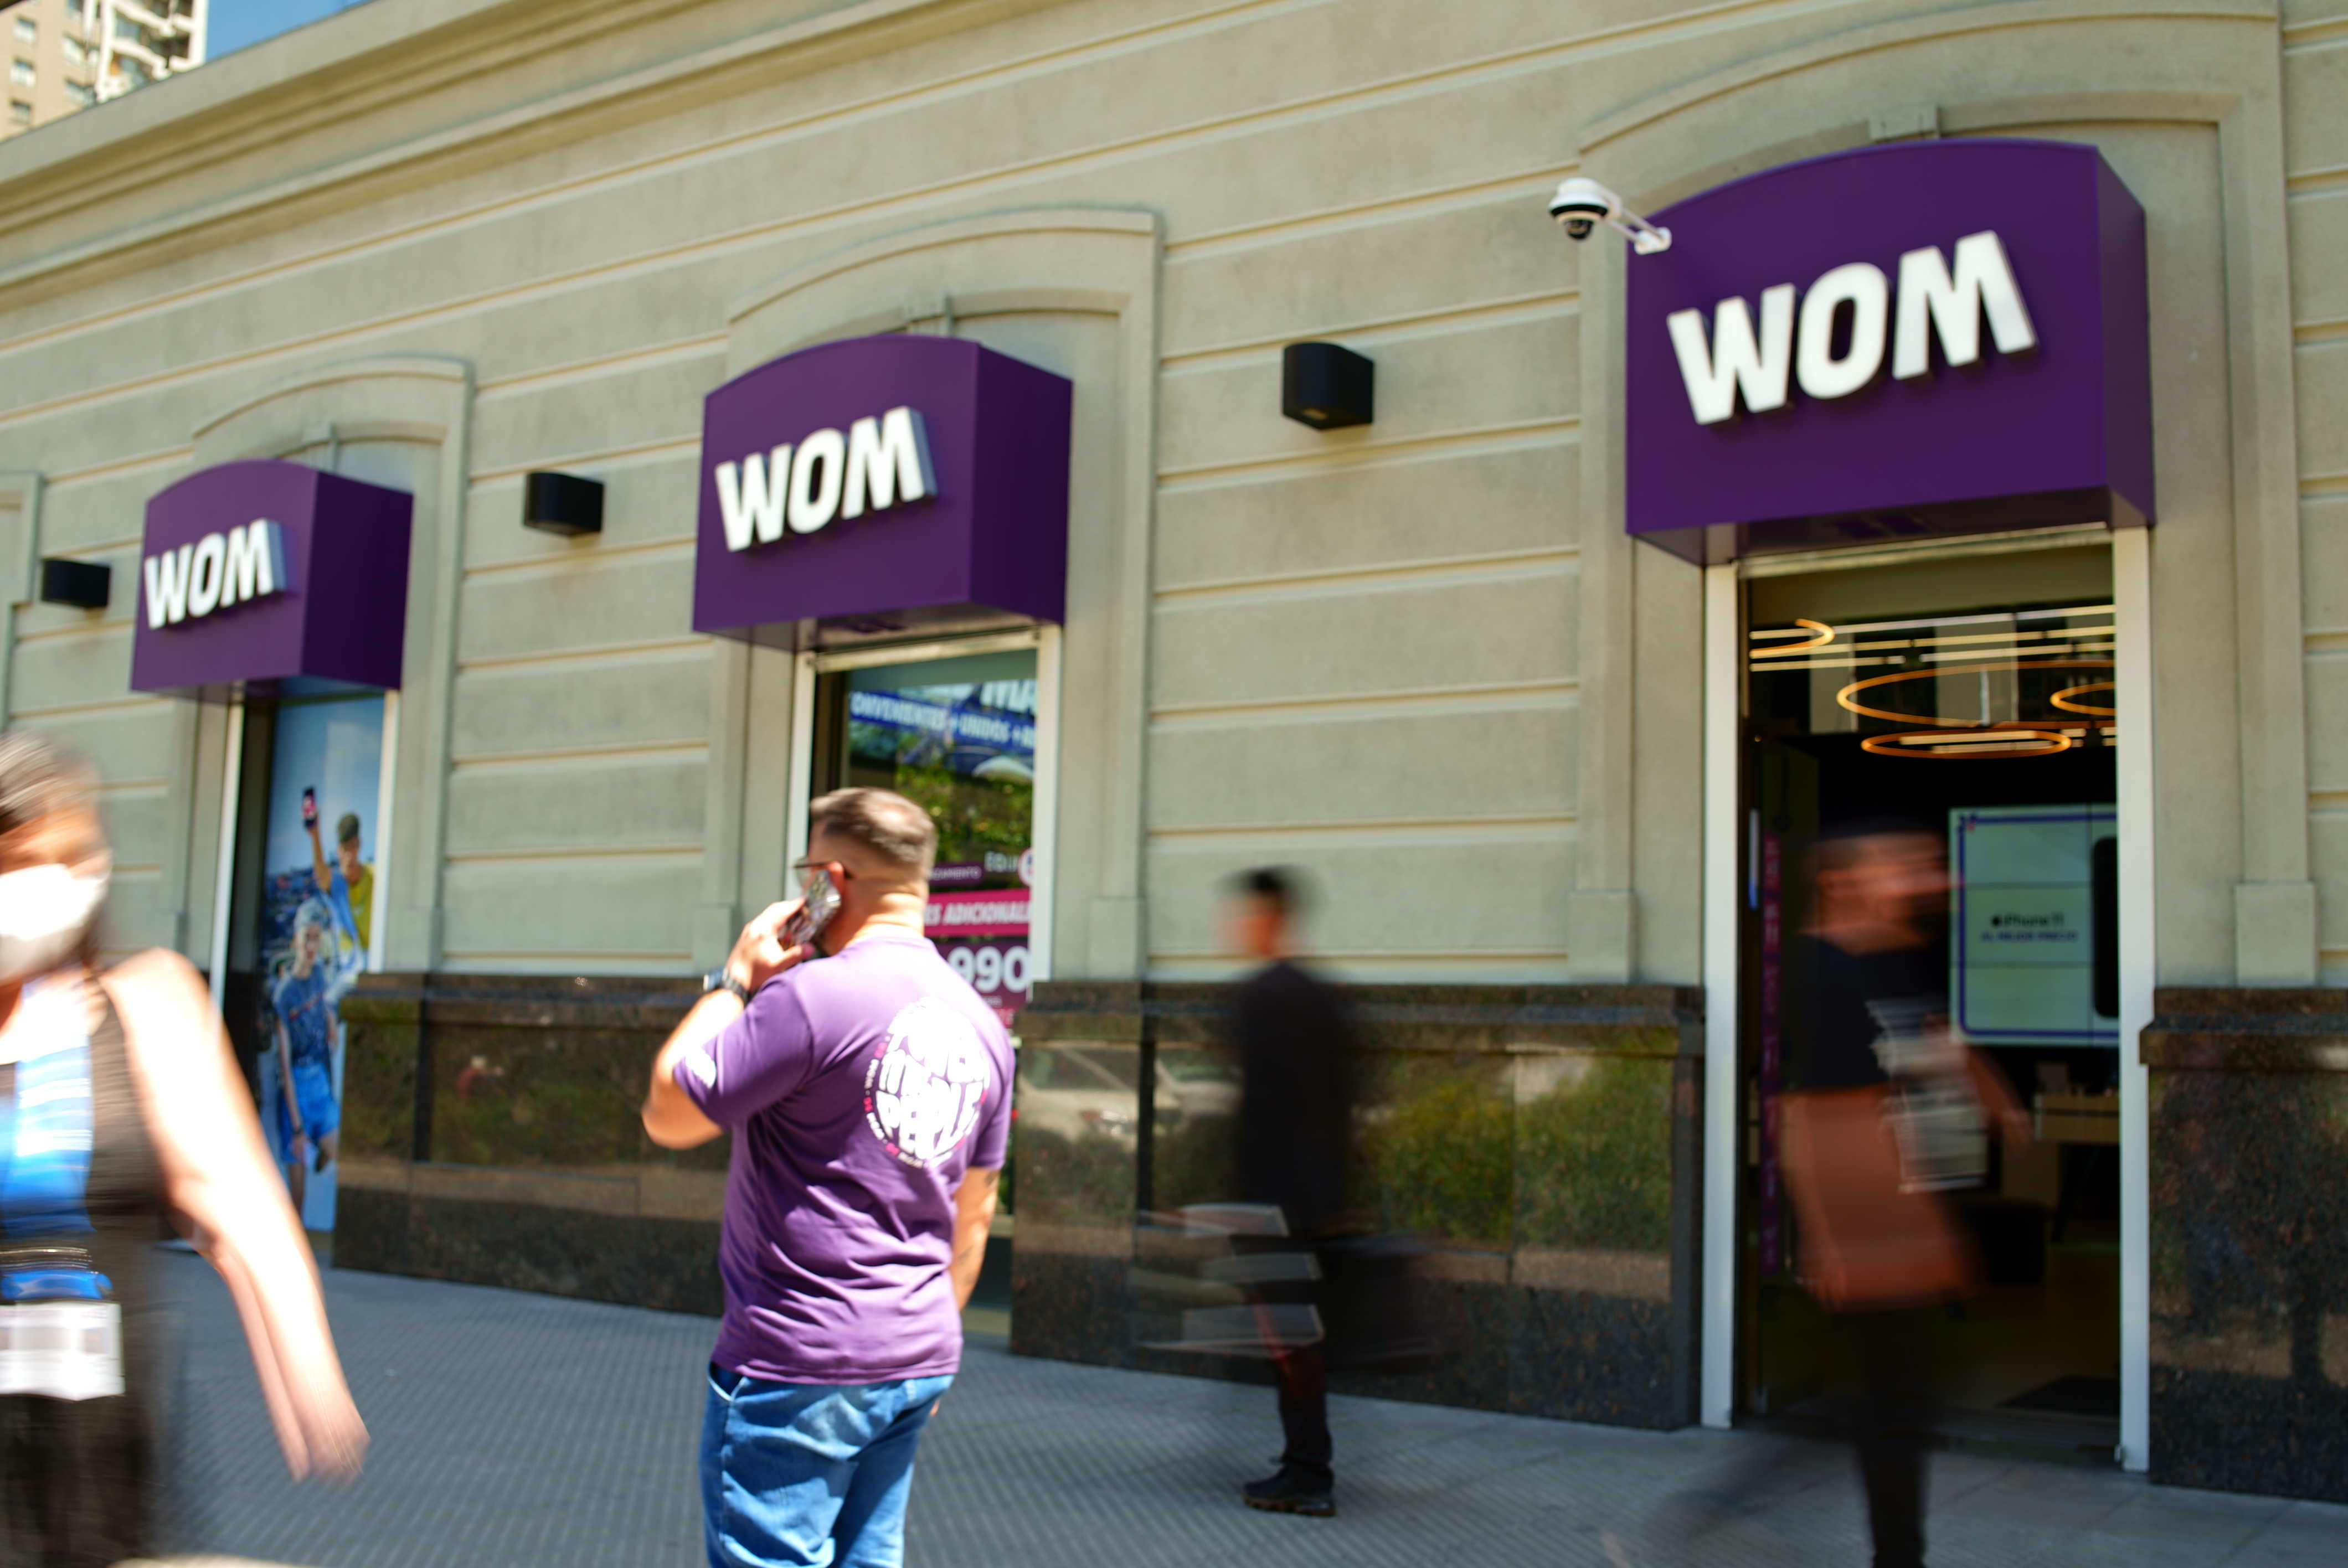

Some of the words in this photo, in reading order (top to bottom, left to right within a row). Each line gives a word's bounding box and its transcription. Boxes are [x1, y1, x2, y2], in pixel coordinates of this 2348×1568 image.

[1666, 229, 2037, 425] WOM
[714, 405, 936, 552] WOM
[144, 517, 284, 630] WOM
